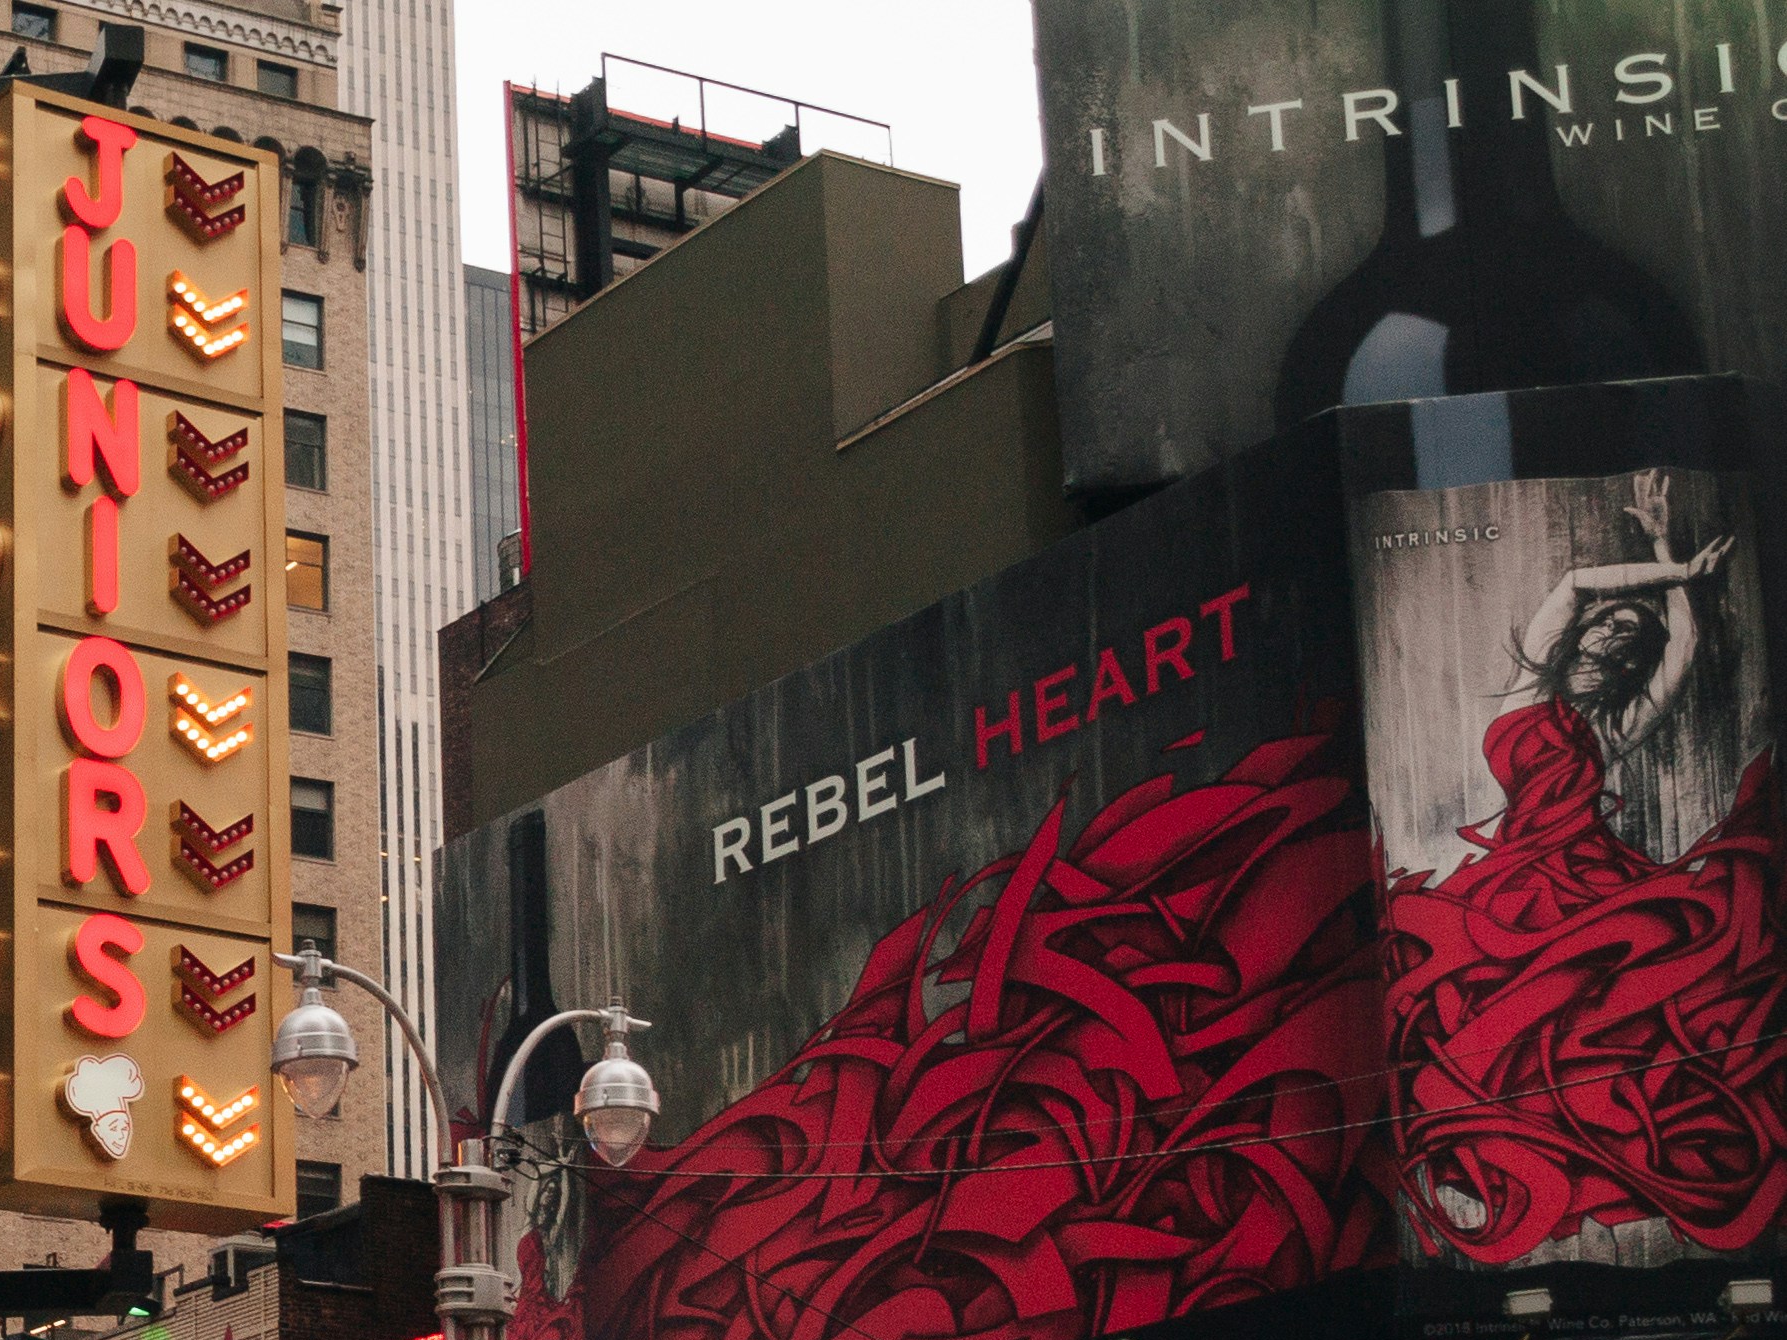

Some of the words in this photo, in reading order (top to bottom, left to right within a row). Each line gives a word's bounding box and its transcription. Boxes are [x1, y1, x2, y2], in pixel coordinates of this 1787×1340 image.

[1089, 41, 1787, 177] INTRINSI
[1555, 107, 1721, 147] WINE
[62, 116, 152, 1038] JUNIORS
[1375, 525, 1501, 550] INTRINSIC
[712, 737, 946, 884] REBEL
[974, 583, 1250, 769] HEART
